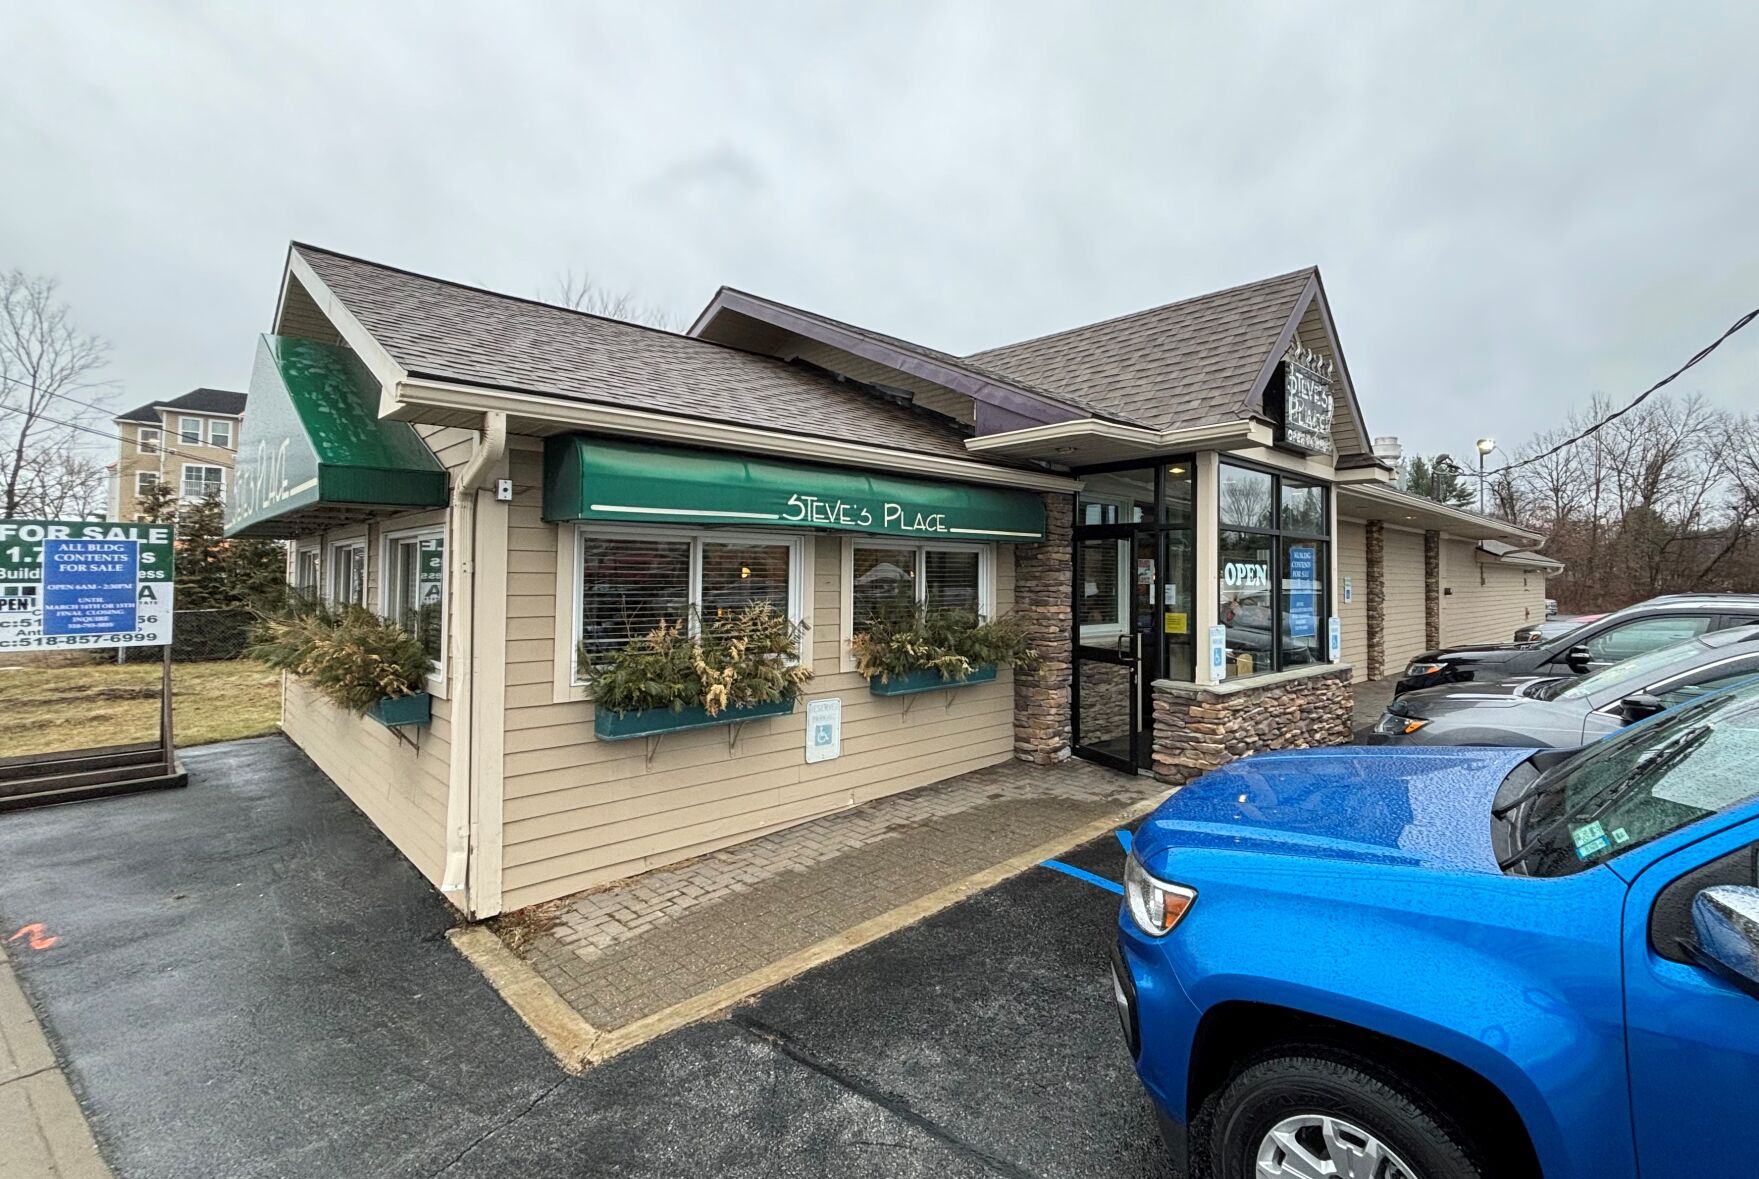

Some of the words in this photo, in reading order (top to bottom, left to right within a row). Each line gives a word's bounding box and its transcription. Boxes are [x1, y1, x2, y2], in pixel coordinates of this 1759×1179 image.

[783, 493, 872, 526] STEVE'S
[884, 503, 948, 532] PLACE
[0, 524, 71, 541] FOR
[82, 526, 169, 544] SALE
[58, 543, 85, 551] ALL
[87, 543, 125, 551] BLDG
[54, 553, 129, 562] CONTENTS
[0, 567, 41, 579] Build
[59, 563, 88, 572] FOR
[90, 563, 124, 572] SALE
[1224, 562, 1268, 587] OPEN
[47, 583, 75, 591] OPEN
[0, 598, 28, 610] PEN
